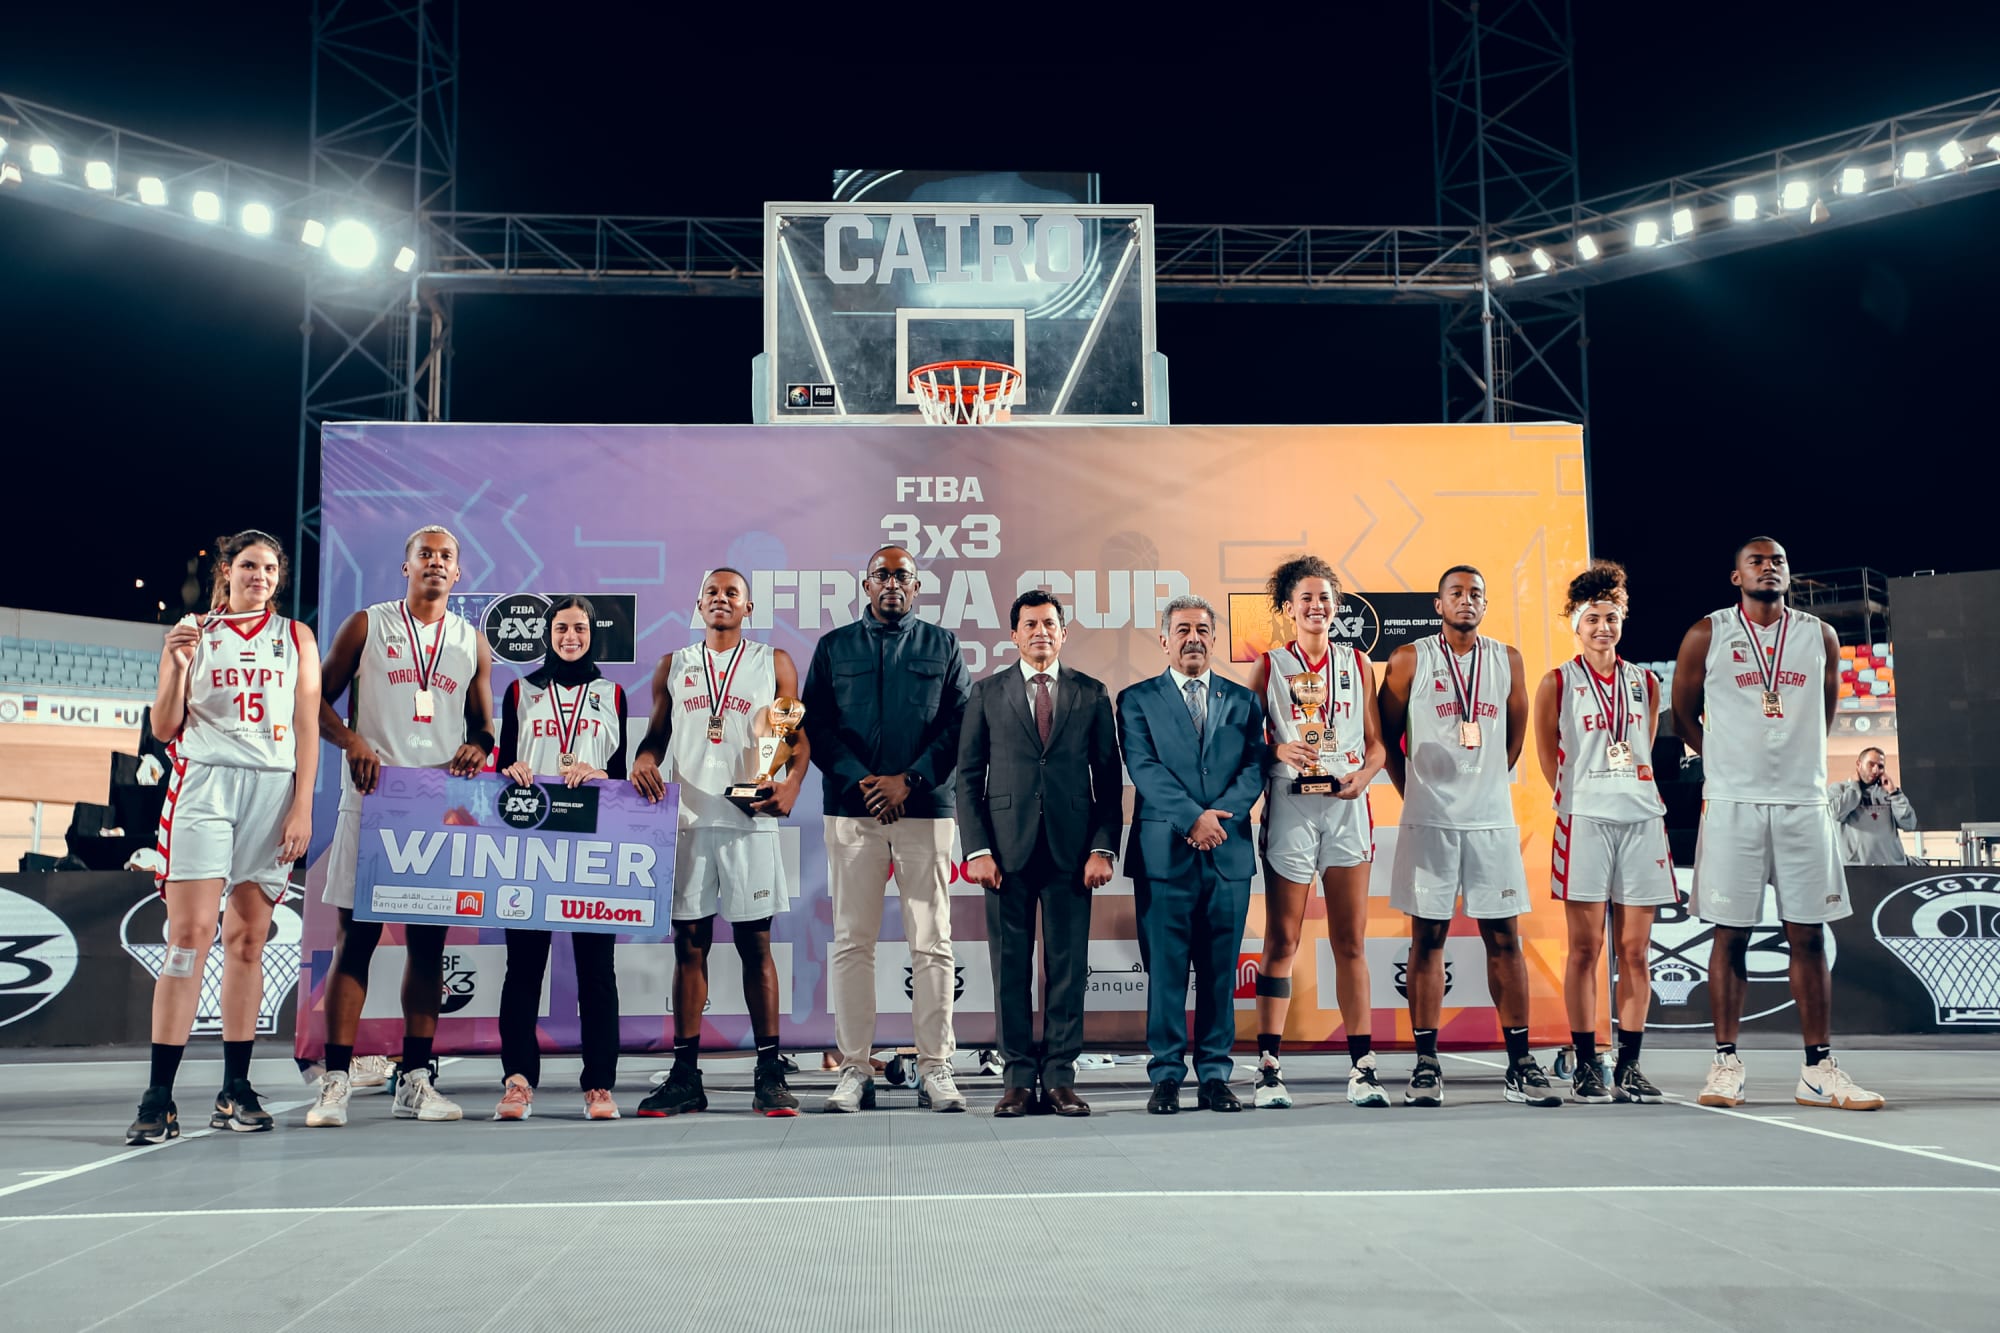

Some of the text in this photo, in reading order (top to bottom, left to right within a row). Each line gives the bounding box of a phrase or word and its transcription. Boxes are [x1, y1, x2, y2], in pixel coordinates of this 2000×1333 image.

[824, 214, 1084, 285] CAIRO
[896, 476, 985, 502] FIBA
[880, 514, 1001, 559] 3x3
[510, 605, 535, 615] FIBA
[1335, 604, 1353, 614] IBA
[596, 620, 614, 628] CUP
[508, 642, 534, 652] 2022
[211, 668, 285, 689] EGYPT
[387, 669, 458, 695] MADASCAR
[1735, 671, 1807, 689] MADASCAR
[59, 704, 99, 723] UCI
[233, 692, 265, 724] 15
[683, 694, 752, 716] MADASCAR
[532, 718, 601, 737] EGPT
[1582, 712, 1643, 733] EGPT
[512, 814, 530, 822] 2022
[379, 828, 657, 888] WINNER
[373, 900, 452, 911] Banque du Caire
[560, 899, 643, 922] Wilson
